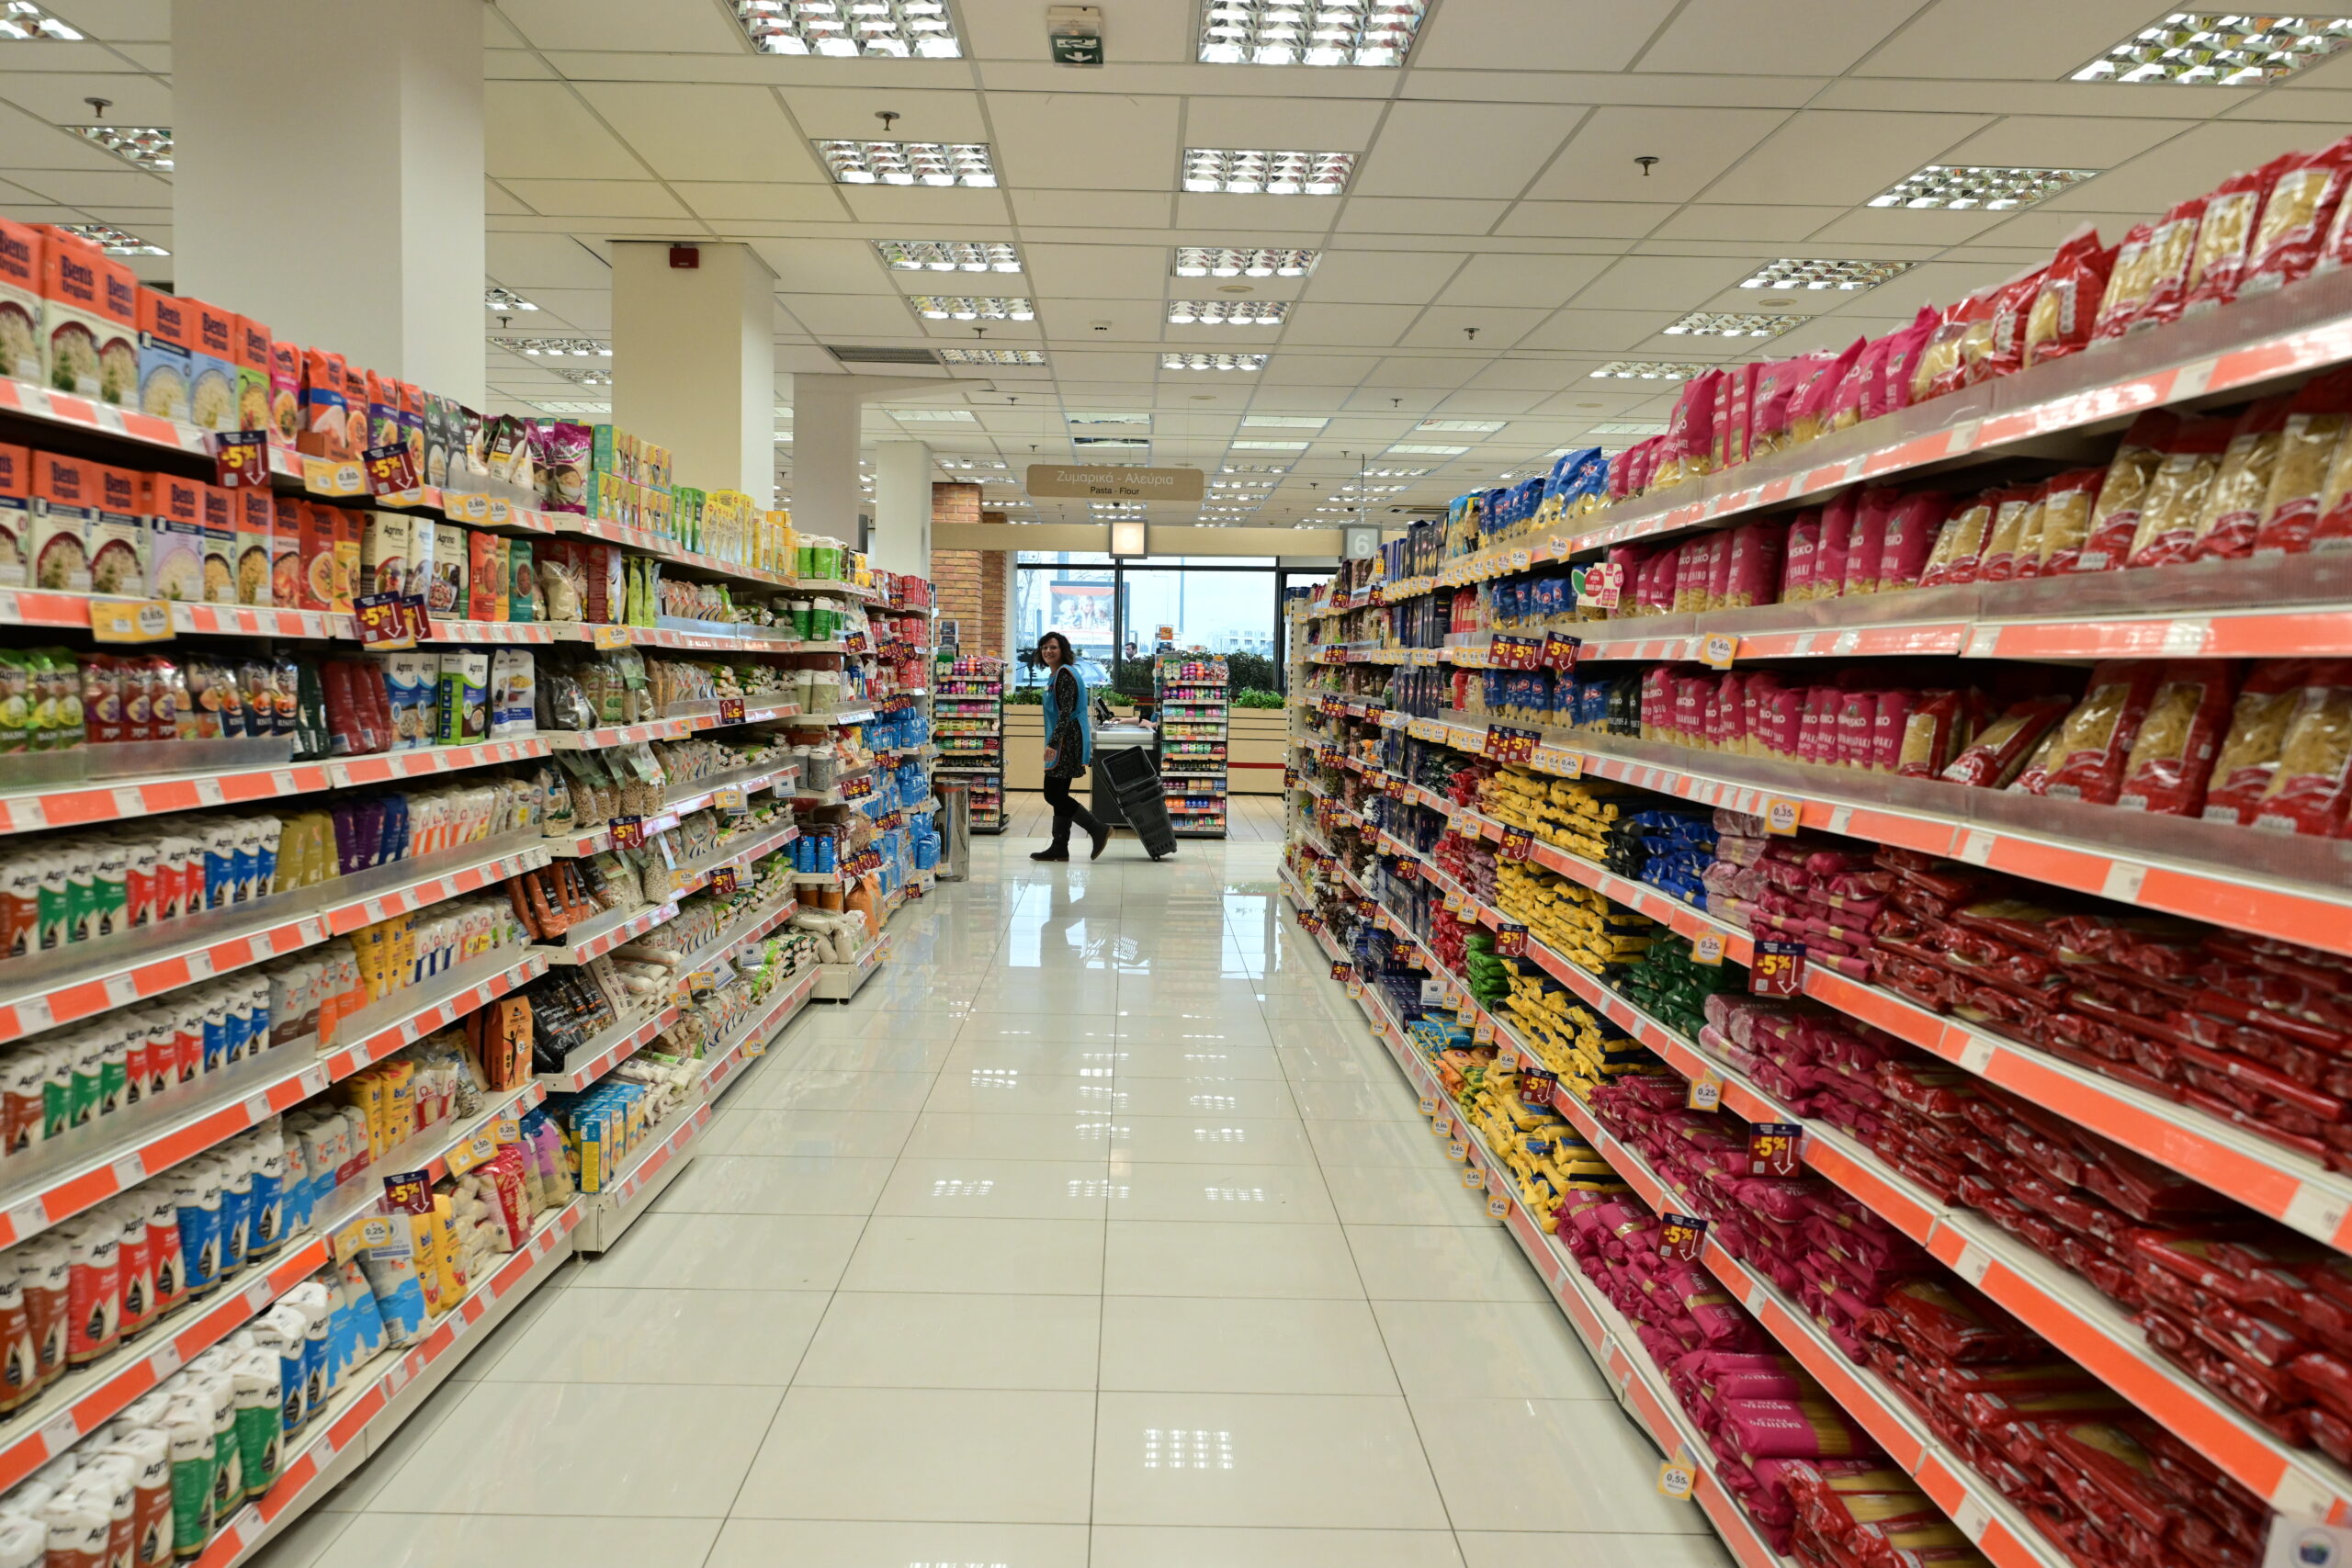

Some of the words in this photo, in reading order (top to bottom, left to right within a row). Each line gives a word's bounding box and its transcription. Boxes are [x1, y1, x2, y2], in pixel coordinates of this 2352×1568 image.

[371, 456, 401, 479] -5%
[1057, 470, 1114, 484] Ζυμαρικά
[1125, 472, 1174, 486] Αλεύρια
[1091, 486, 1112, 495] Pasta
[1119, 487, 1140, 496] Flour
[1354, 535, 1370, 553] 6
[361, 605, 391, 626] -5%
[1511, 645, 1533, 659] -5%
[1547, 641, 1570, 656] -5%
[1510, 737, 1532, 750] -5%
[1503, 834, 1524, 848] -5%
[1498, 931, 1520, 944] -5%
[1757, 954, 1792, 976] -5%
[1526, 1077, 1548, 1090] -5%
[1754, 1136, 1788, 1157] -5%
[390, 1183, 420, 1202] -5%
[1663, 1225, 1693, 1244] -5%
